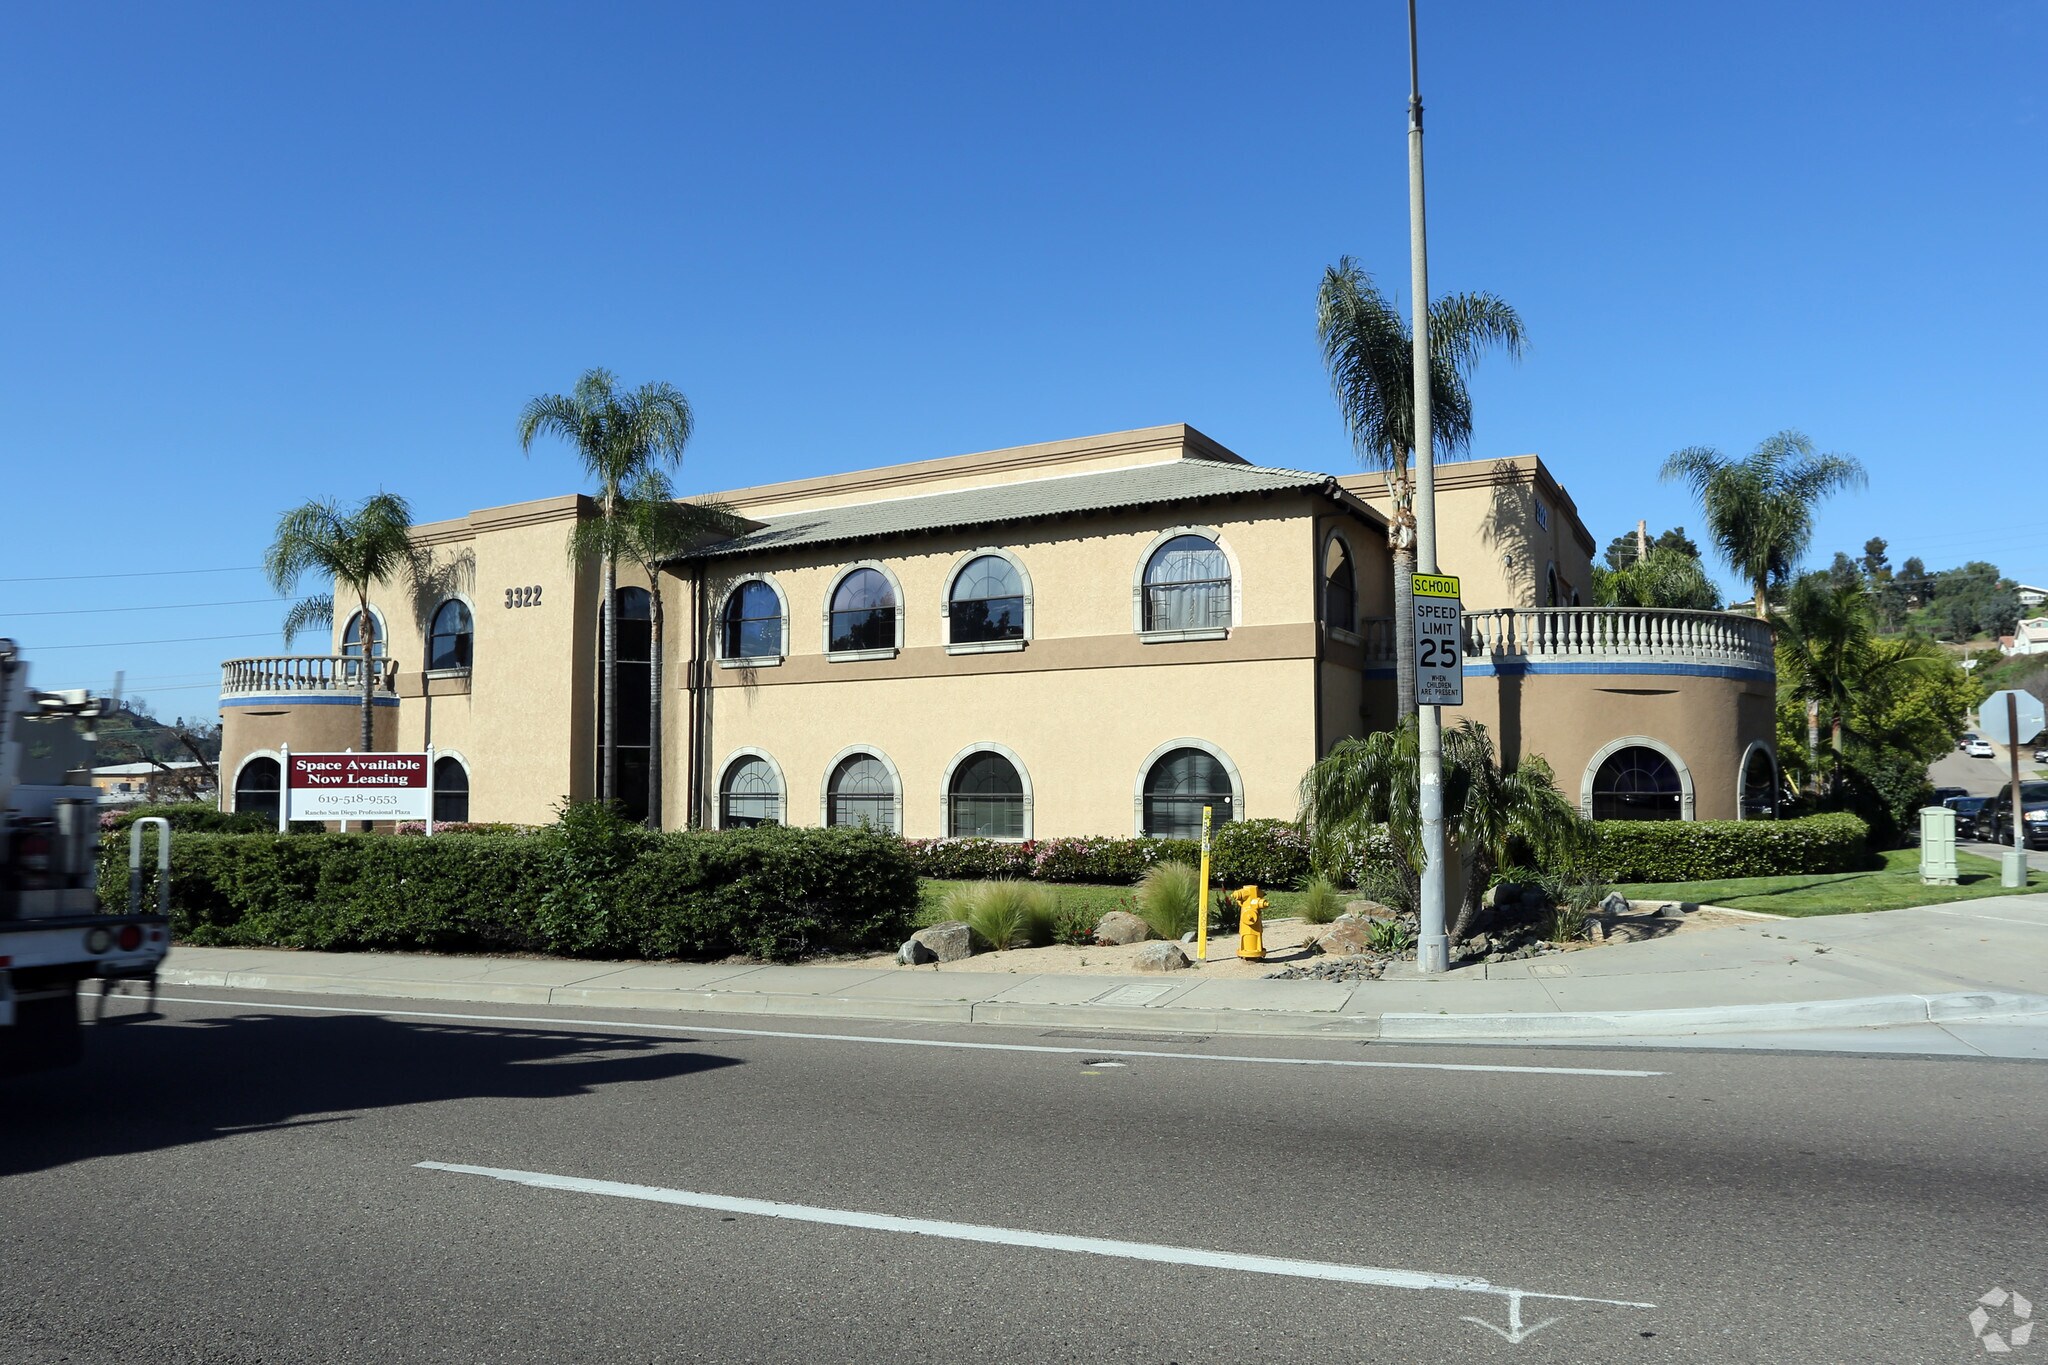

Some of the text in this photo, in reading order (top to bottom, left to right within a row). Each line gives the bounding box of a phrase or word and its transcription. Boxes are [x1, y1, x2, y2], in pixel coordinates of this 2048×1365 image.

[1415, 579, 1458, 594] SCHOOL
[504, 585, 542, 609] 3322
[1418, 605, 1457, 619] SPEED
[1422, 622, 1453, 635] LIMIT
[1420, 638, 1457, 668] 25
[1426, 681, 1452, 689] CHILDREN
[296, 760, 420, 772] Space Available
[307, 774, 408, 786] Now Leasing
[318, 794, 398, 805] 619-518-9553
